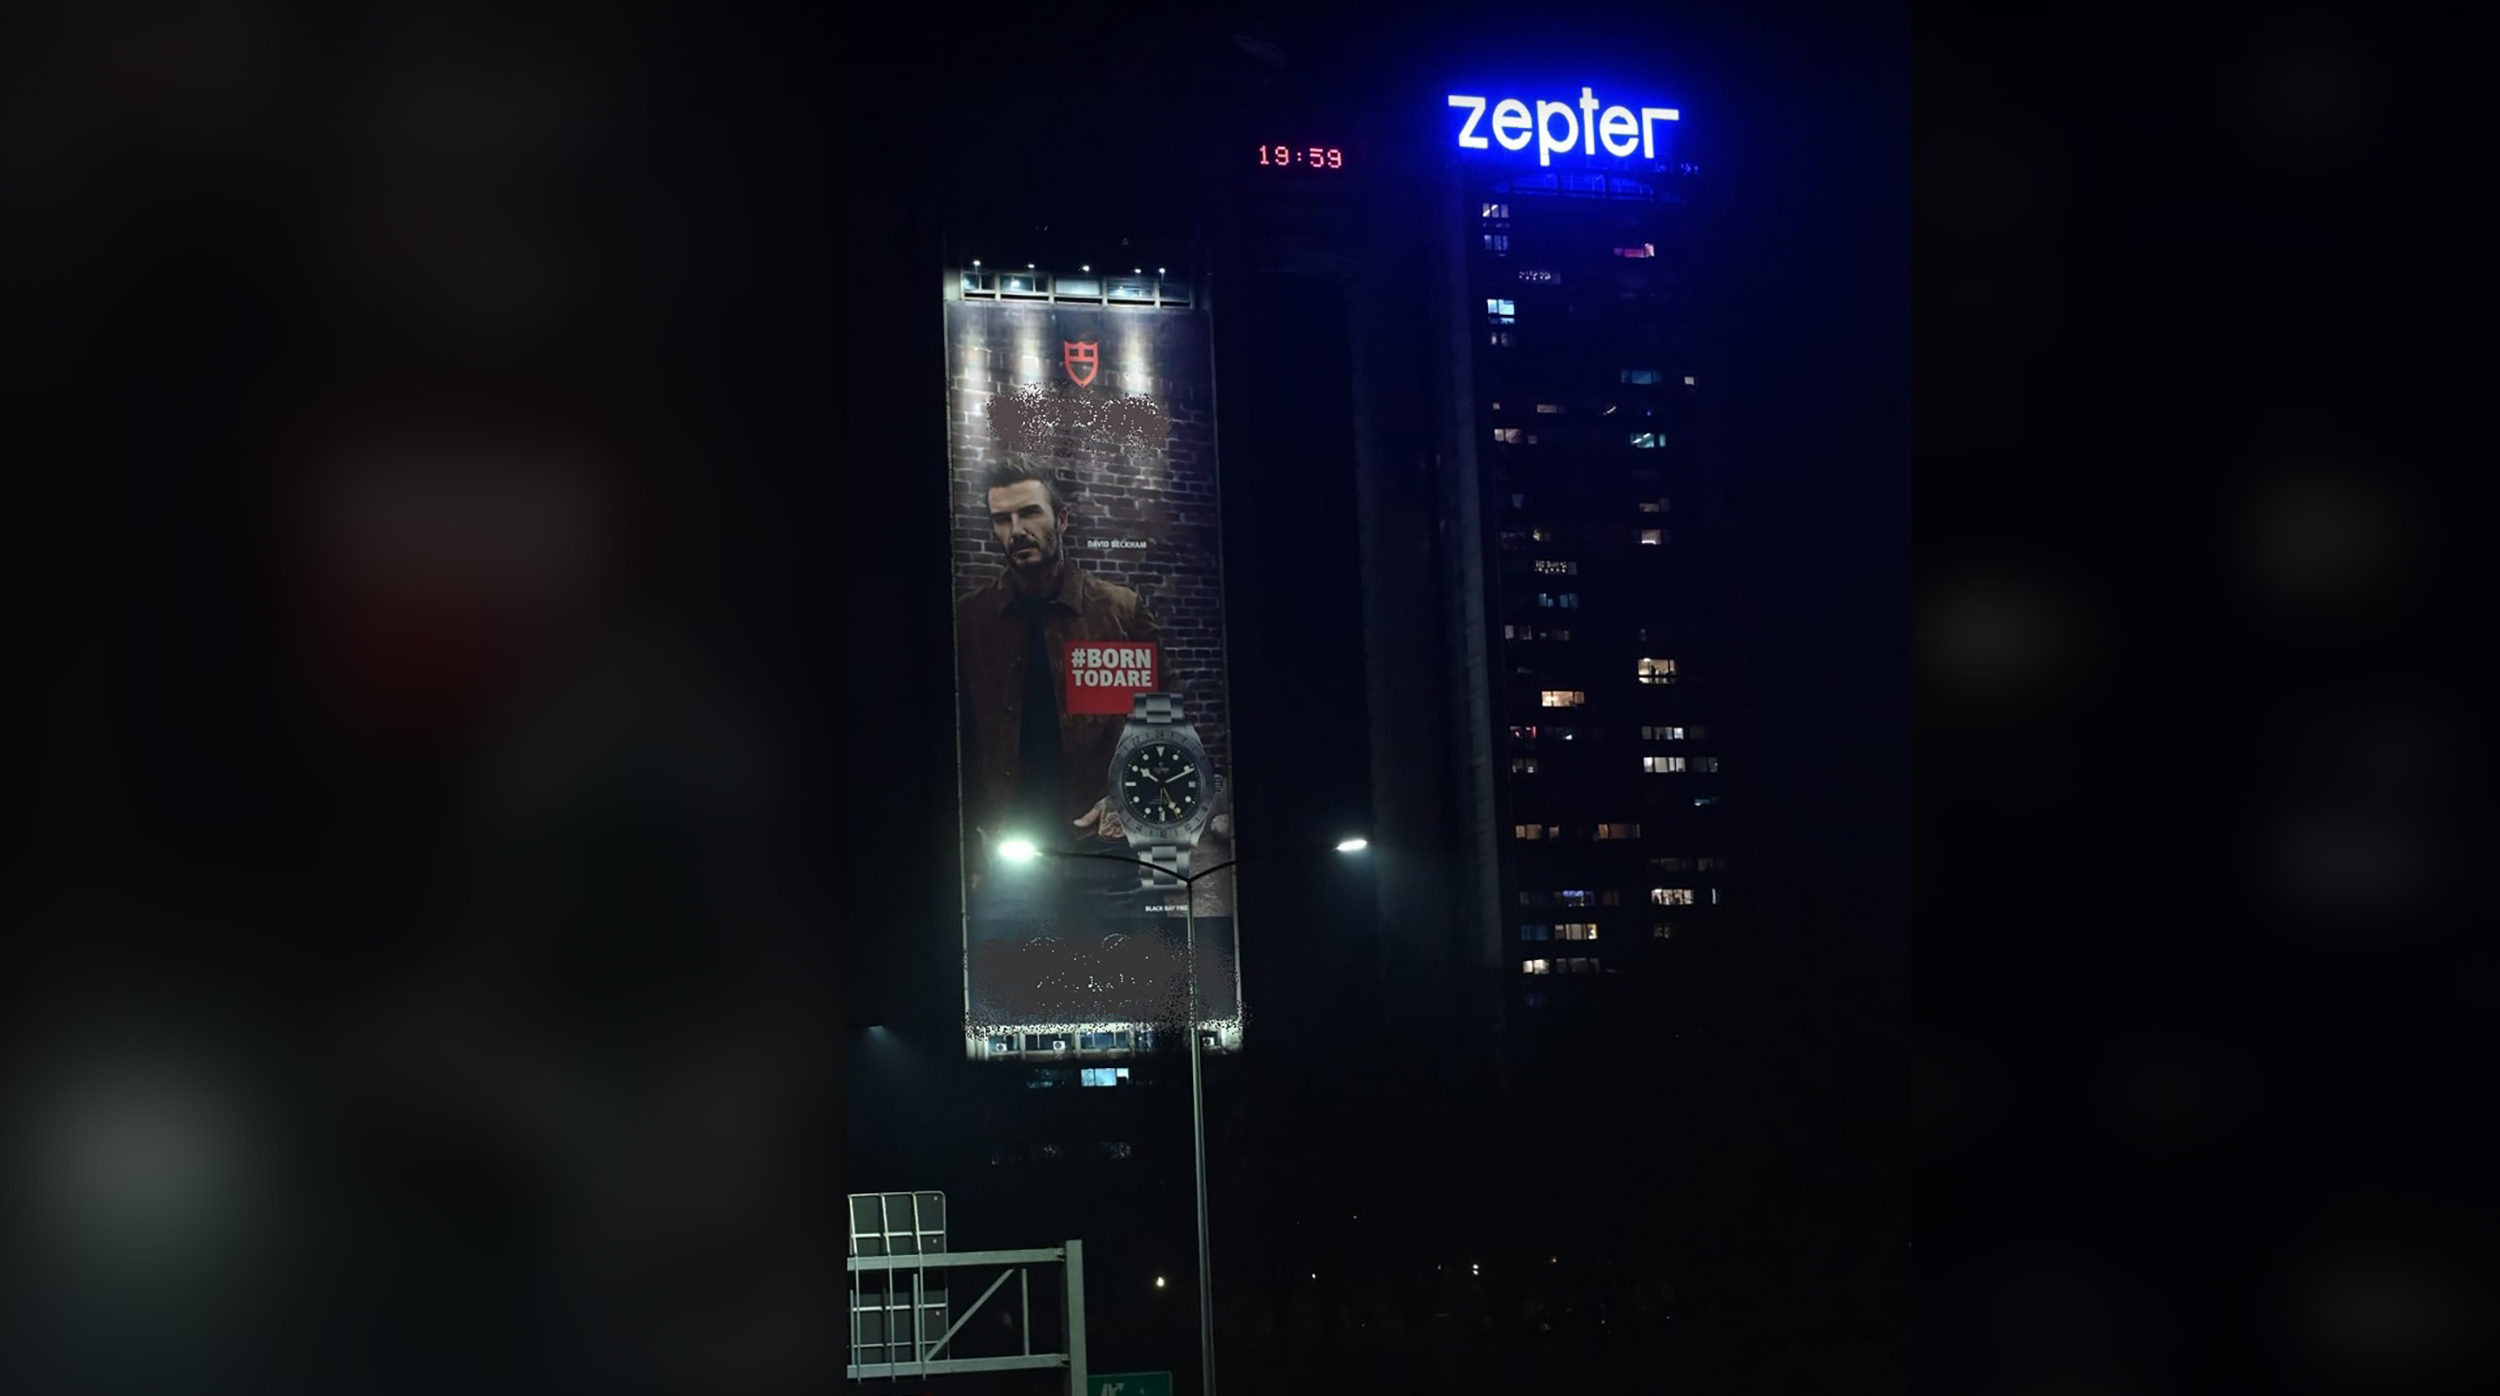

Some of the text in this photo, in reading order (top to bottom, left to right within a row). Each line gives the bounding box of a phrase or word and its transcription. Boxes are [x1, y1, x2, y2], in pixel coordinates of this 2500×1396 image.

[1448, 87, 1680, 167] zepter
[1259, 145, 1342, 169] 19:59
[1087, 539, 1147, 549] DAVID BECKHAM
[1071, 648, 1152, 669] #BORN
[1072, 669, 1153, 687] TODARE
